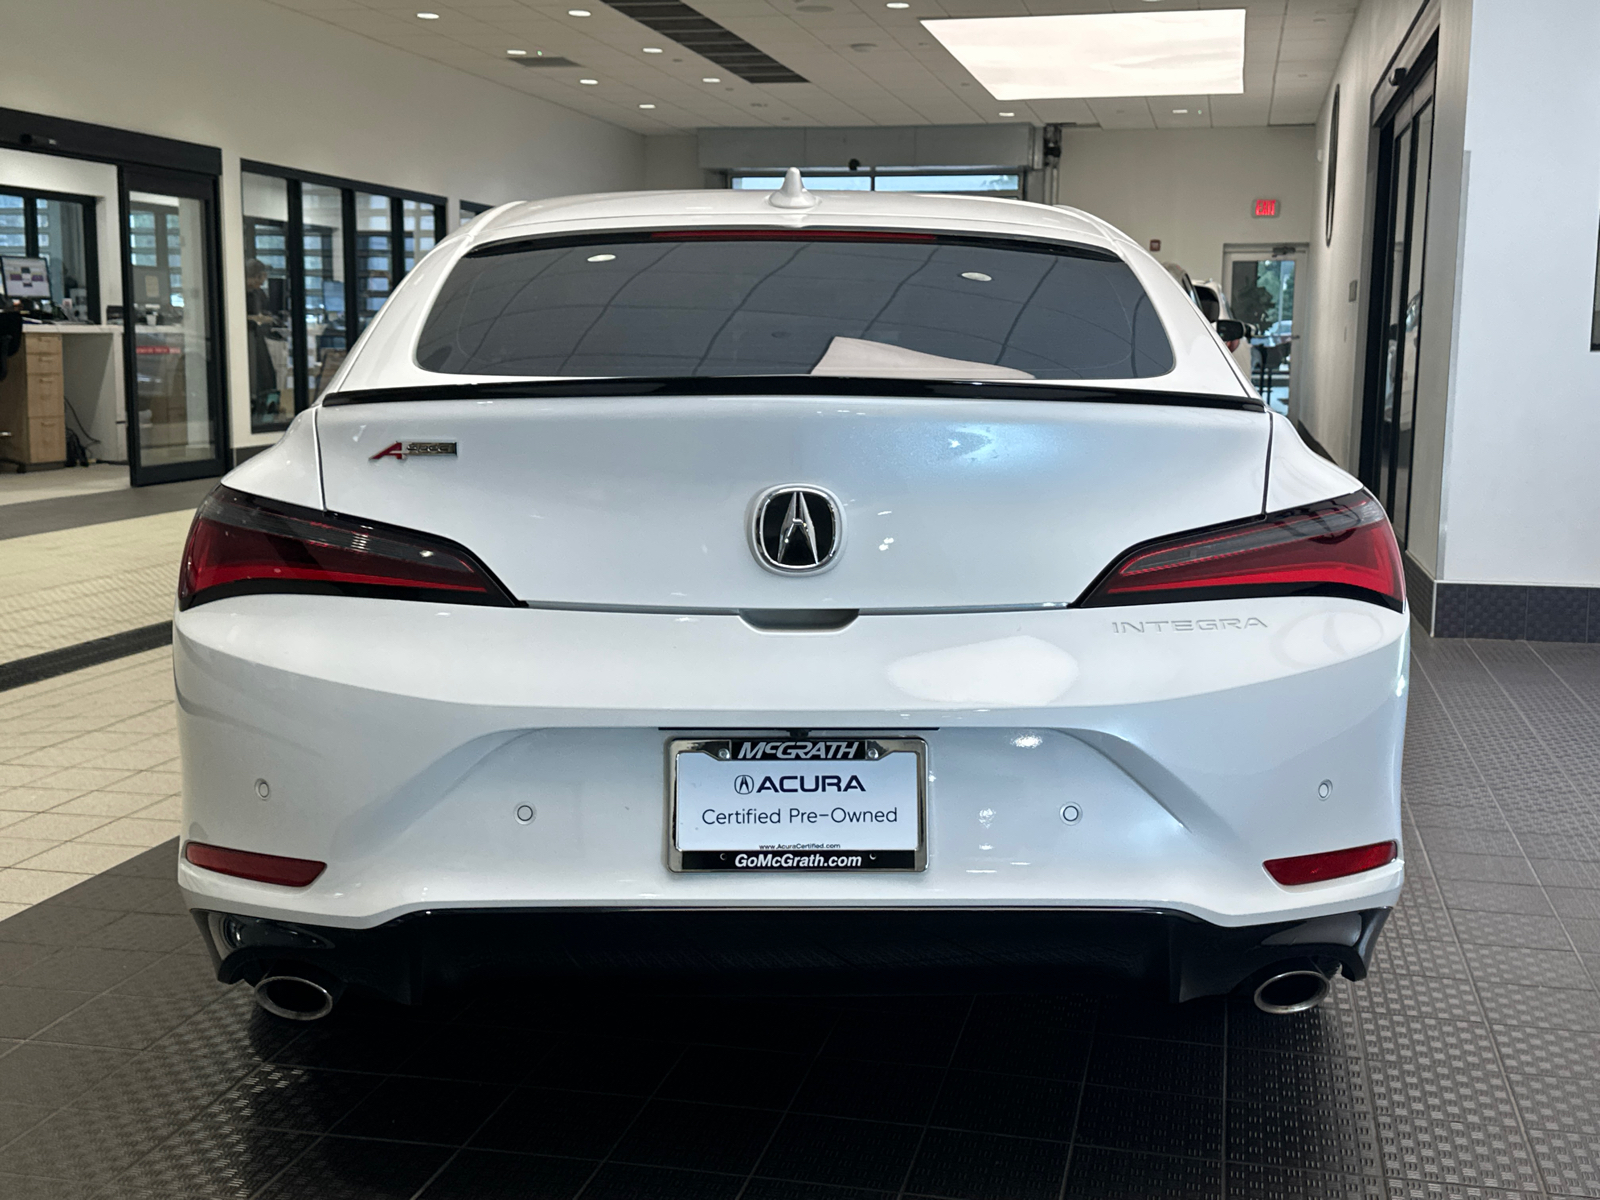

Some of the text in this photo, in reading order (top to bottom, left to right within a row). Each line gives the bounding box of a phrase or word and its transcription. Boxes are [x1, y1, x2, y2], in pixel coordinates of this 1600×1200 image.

[1255, 199, 1276, 215] EXIT
[1112, 617, 1268, 633] INTEGRA
[756, 775, 866, 793] ACURA
[702, 807, 898, 825] Certified Pre-Owned
[735, 853, 862, 868] GoMcGrath.com
